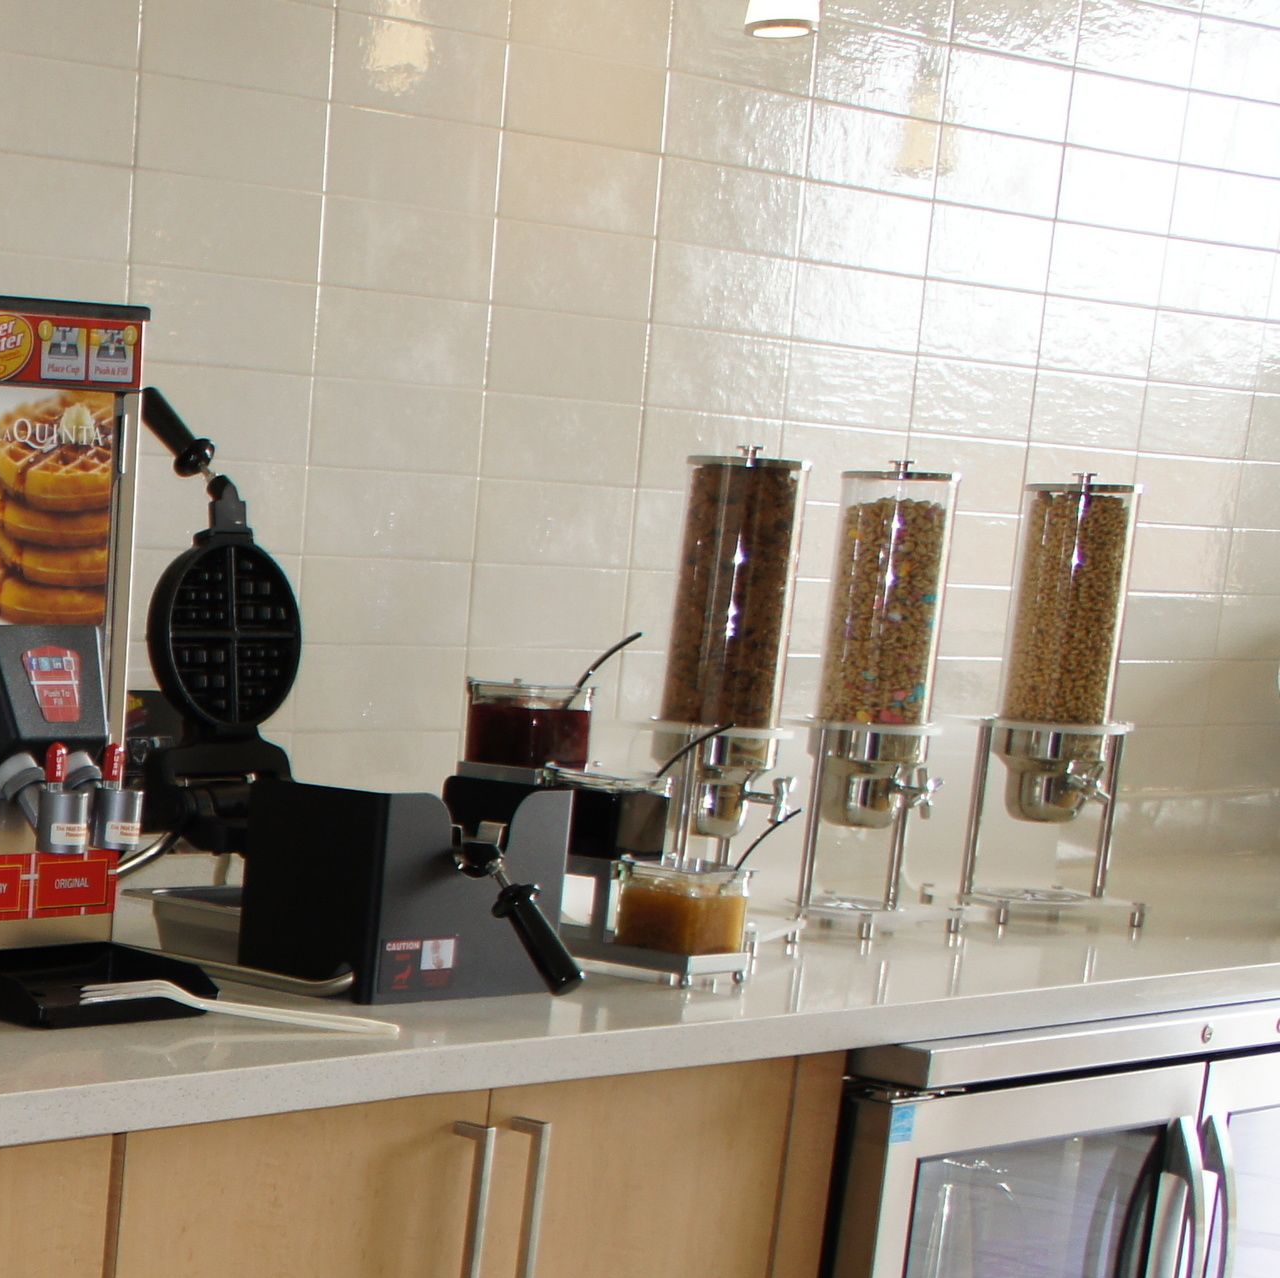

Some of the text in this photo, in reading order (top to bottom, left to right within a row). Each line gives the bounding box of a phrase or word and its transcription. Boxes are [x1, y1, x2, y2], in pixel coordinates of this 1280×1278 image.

[13, 418, 104, 449] QUINTA
[54, 877, 89, 889] ORIGINAL
[386, 940, 420, 951] CAUTION
